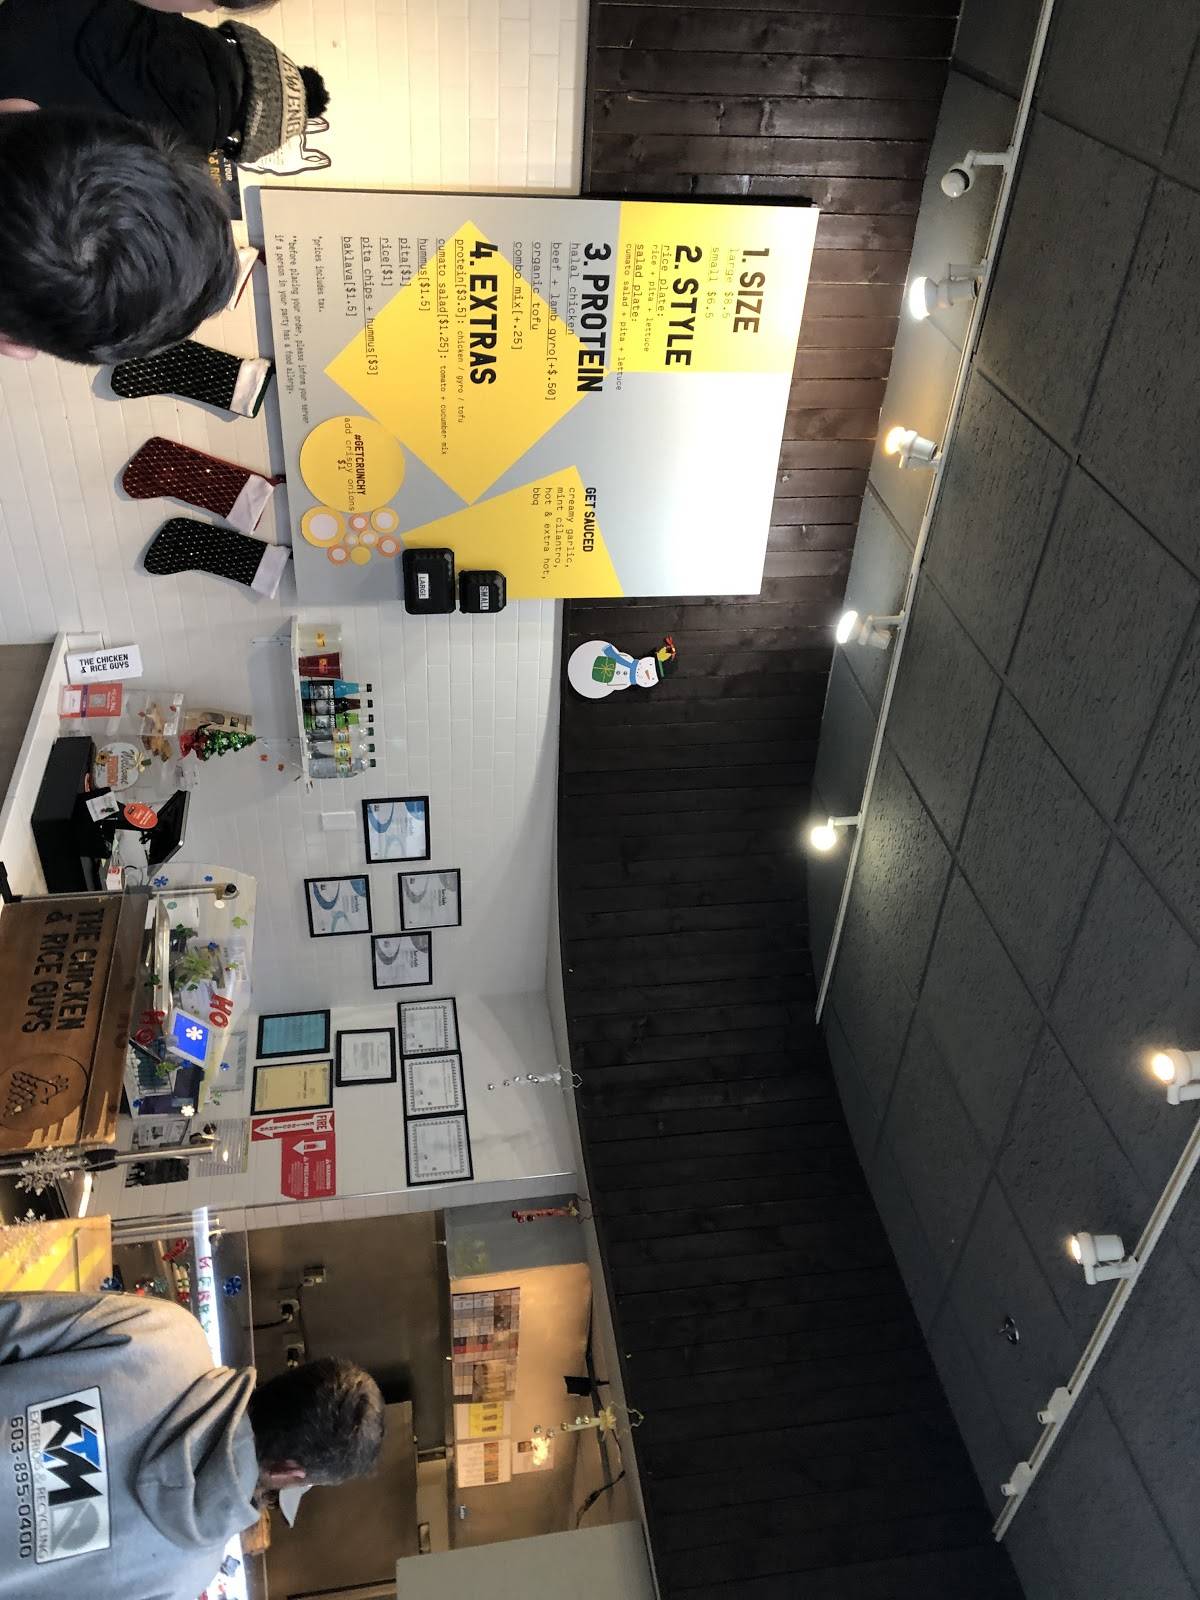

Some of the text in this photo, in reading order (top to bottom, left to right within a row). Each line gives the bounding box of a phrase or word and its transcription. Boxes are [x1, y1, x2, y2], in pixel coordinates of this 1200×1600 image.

[274, 234, 284, 243] if
[360, 237, 374, 262] pita
[275, 253, 286, 277] person
[380, 238, 392, 287] rice[$1]
[398, 238, 412, 287] pita[$1]
[438, 238, 446, 276] cumato
[513, 242, 524, 280] combo
[551, 242, 562, 272] beef
[624, 244, 632, 276] cumato
[650, 244, 659, 266] rice
[278, 279, 287, 288] in
[289, 268, 300, 296] placing
[316, 266, 325, 296] includes
[342, 236, 357, 316] baklava[$1.5]
[362, 268, 376, 300] chips
[418, 238, 431, 312] hummus[$1.5]
[530, 242, 542, 330] organic tofu
[567, 242, 580, 336] halal chicken
[630, 244, 646, 322] salad plate:
[656, 245, 672, 317] rice plate:
[704, 247, 720, 319] small $6.5
[722, 248, 738, 319] large $8.5
[278, 290, 288, 306] your
[291, 298, 301, 313] your
[317, 298, 326, 312] tax.
[622, 281, 630, 306] salad
[648, 282, 658, 302] pita
[664, 245, 702, 366] 2. STYLE
[733, 248, 770, 333] 1. SIZE
[280, 308, 290, 327] party
[470, 240, 498, 384] 4. EXTRAS
[550, 294, 560, 321] lamb
[577, 242, 612, 392] 3. PROTEIN
[283, 329, 292, 341] has
[293, 316, 304, 337] order,
[618, 322, 628, 342] pita
[643, 318, 654, 352] lettuce
[284, 350, 294, 365] food
[295, 340, 306, 362] please
[366, 318, 378, 376] hummus[$3]
[456, 330, 465, 363] chicken
[285, 367, 296, 394] allergy.
[298, 364, 308, 385] inform
[439, 366, 447, 392] tomato
[456, 375, 464, 394] gyro
[616, 357, 625, 390] lettuce
[298, 388, 308, 401] your
[301, 404, 310, 424] server
[439, 404, 448, 439] cucumber
[456, 406, 466, 423] tofu
[440, 442, 448, 456] mix
[337, 459, 346, 471] $1
[344, 418, 356, 512] add crispy onions
[354, 434, 366, 496] #GETCRUNCHY
[530, 487, 540, 506] bbq
[544, 487, 553, 505] hot
[553, 487, 565, 568] mint cilantro,
[564, 487, 576, 568] creamy garlic,
[582, 488, 596, 552] GET SAUCED
[541, 558, 551, 580] hot,
[418, 576, 426, 598] LARGE
[480, 586, 489, 610] SMALL
[80, 653, 129, 666] THE CHICKEN
[90, 664, 107, 672] RICE
[109, 661, 130, 670] GUYS
[22, 912, 72, 1032] & RICE GUYS
[56, 908, 104, 1030] THE CHICKEN
[208, 994, 234, 1028] HO
[135, 1010, 166, 1046] HO
[316, 1115, 328, 1130] FIRE
[41, 1400, 103, 1506] KTM
[10, 1416, 32, 1559] 603-895-0400
[35, 1487, 48, 1560] RECYCLING
